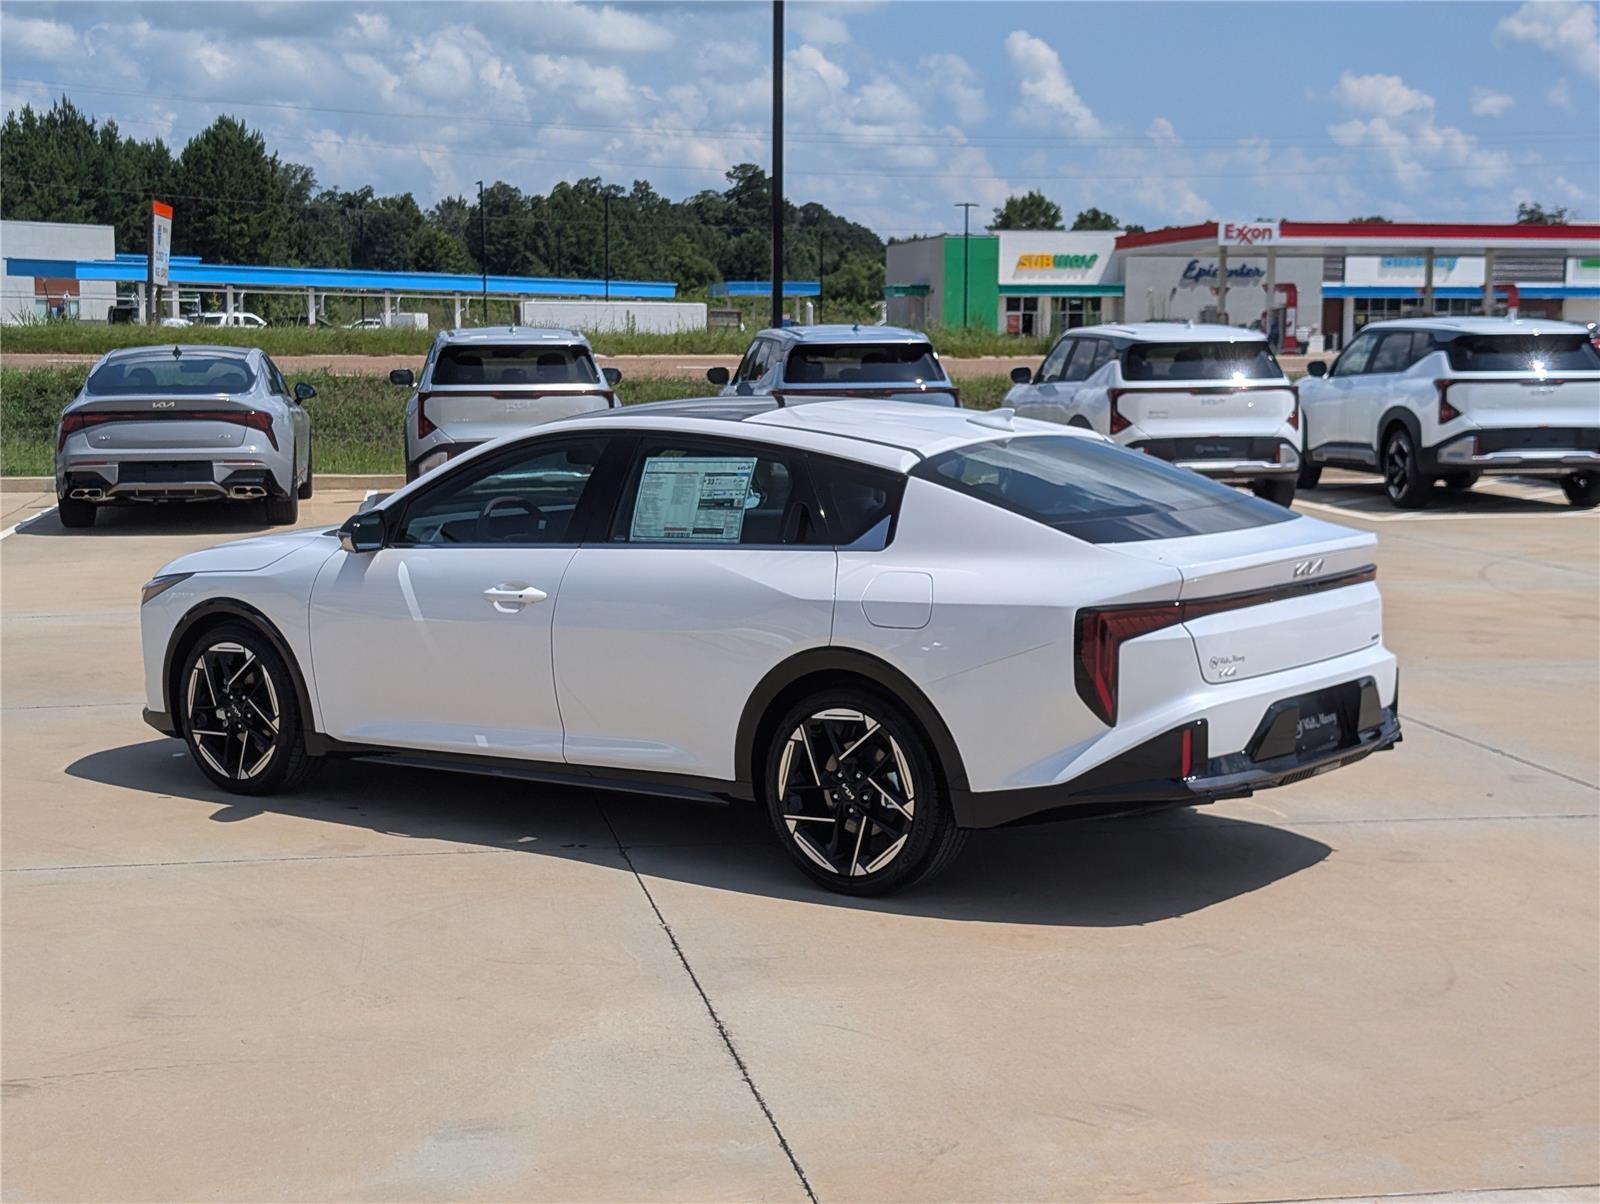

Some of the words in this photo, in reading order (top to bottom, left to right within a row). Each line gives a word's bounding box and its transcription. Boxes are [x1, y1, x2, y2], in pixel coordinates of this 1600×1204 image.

[1224, 223, 1273, 246] Exxon
[1016, 253, 1099, 271] SUBWAY
[1182, 259, 1266, 283] Epicnter
